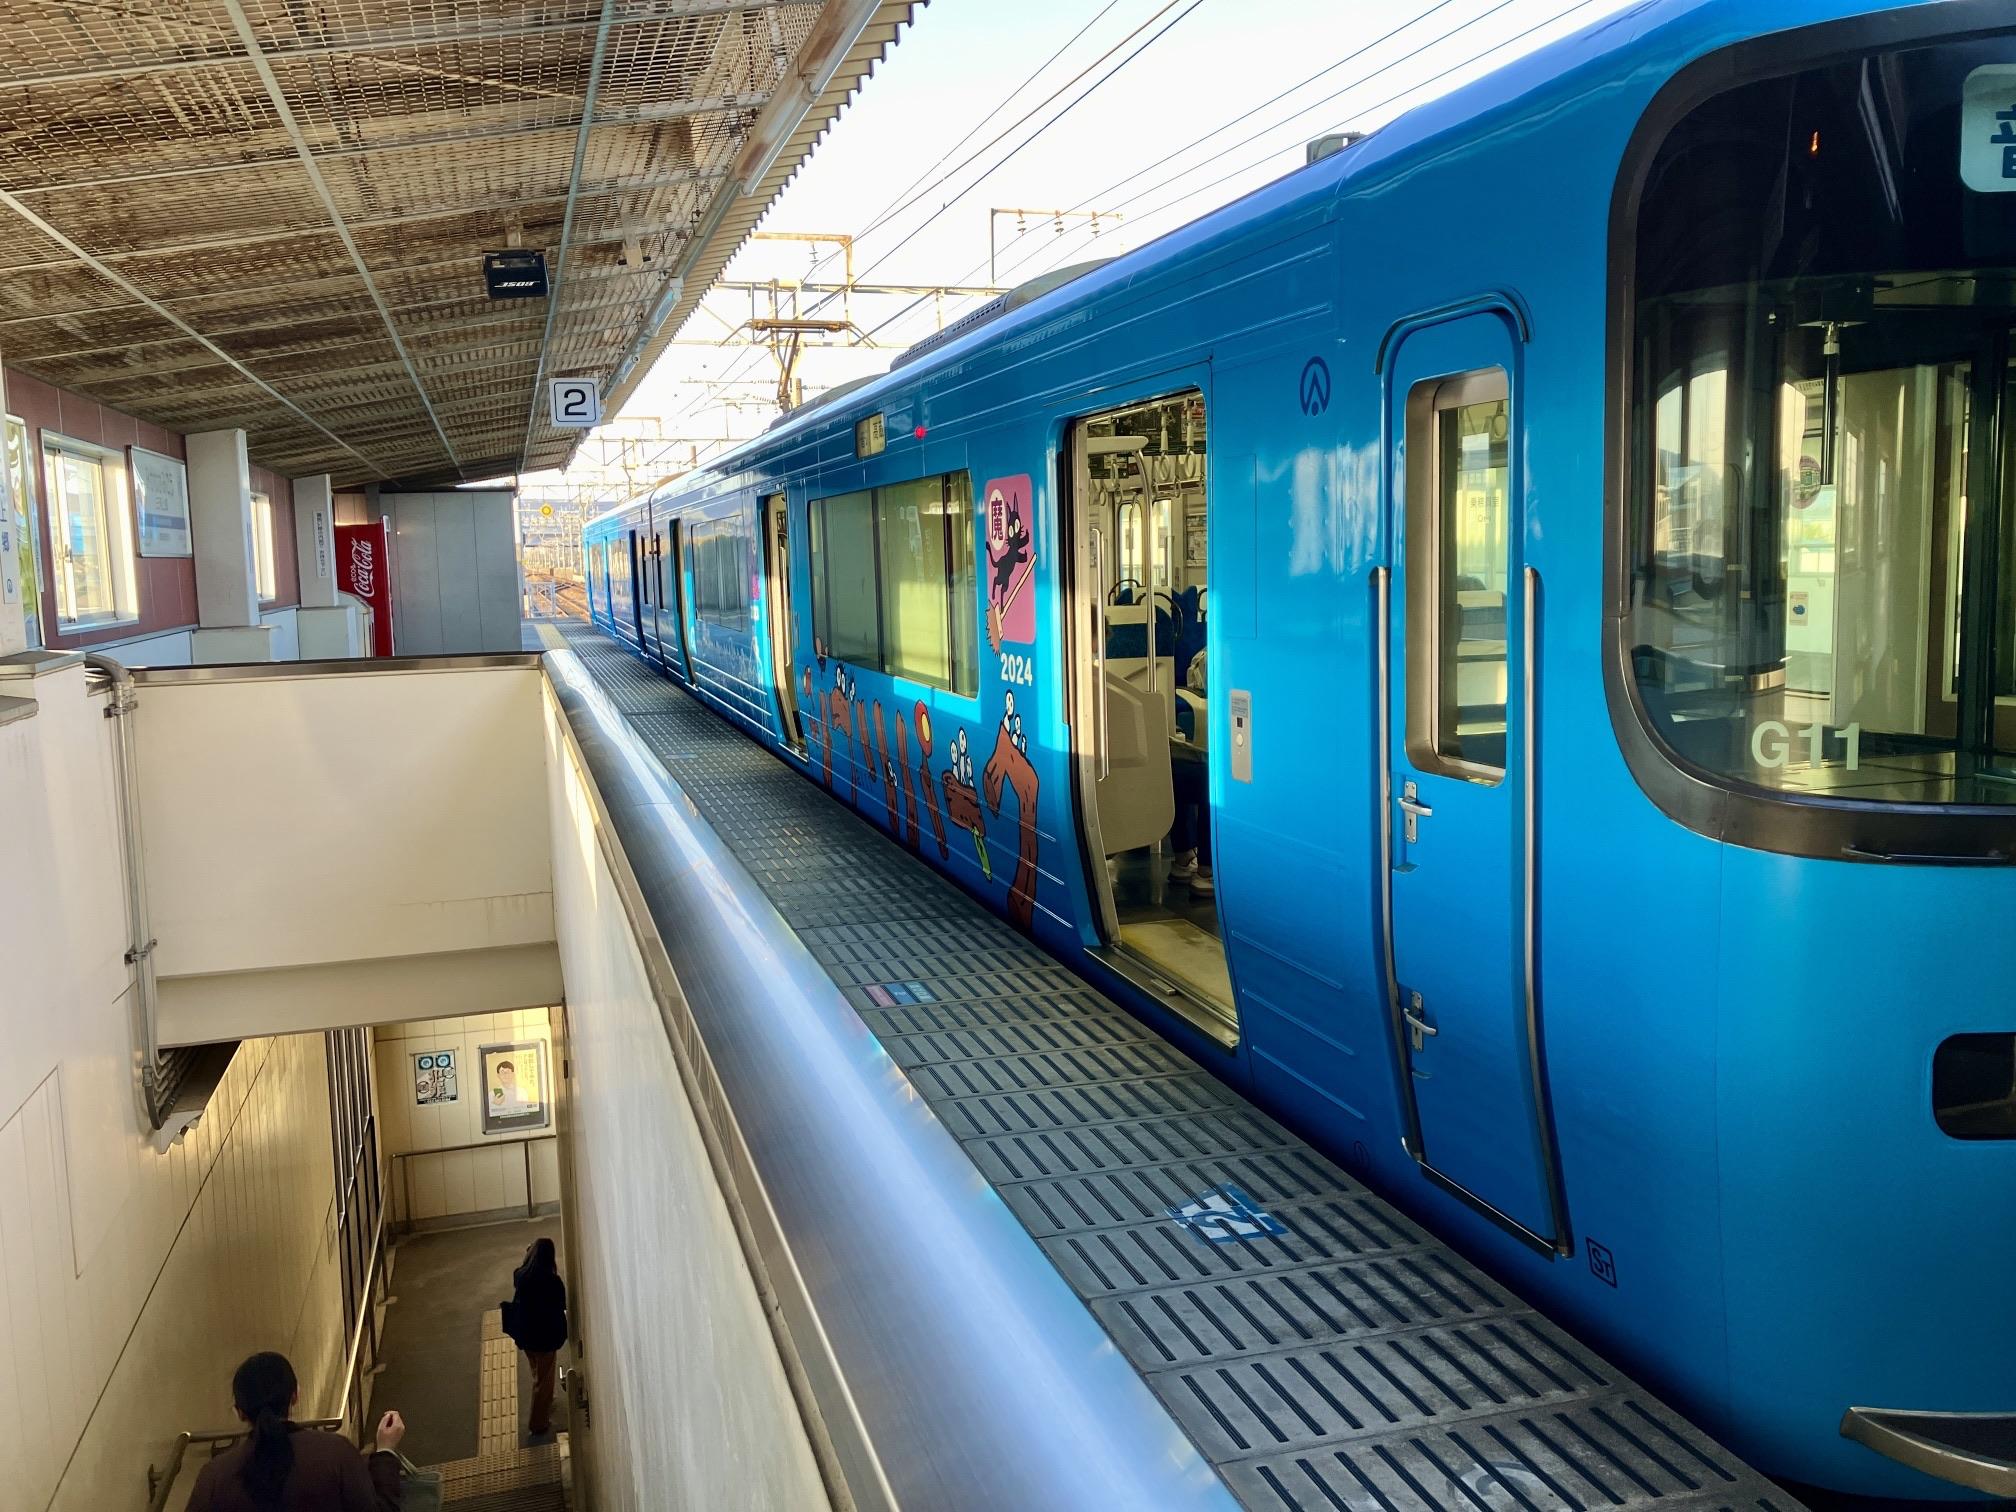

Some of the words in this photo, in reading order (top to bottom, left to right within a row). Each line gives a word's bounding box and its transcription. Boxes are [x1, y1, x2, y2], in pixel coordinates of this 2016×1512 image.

[564, 388, 587, 416] 2
[991, 497, 1004, 540] 魔
[1000, 653, 1032, 687] 2024
[1752, 721, 1860, 771] G11
